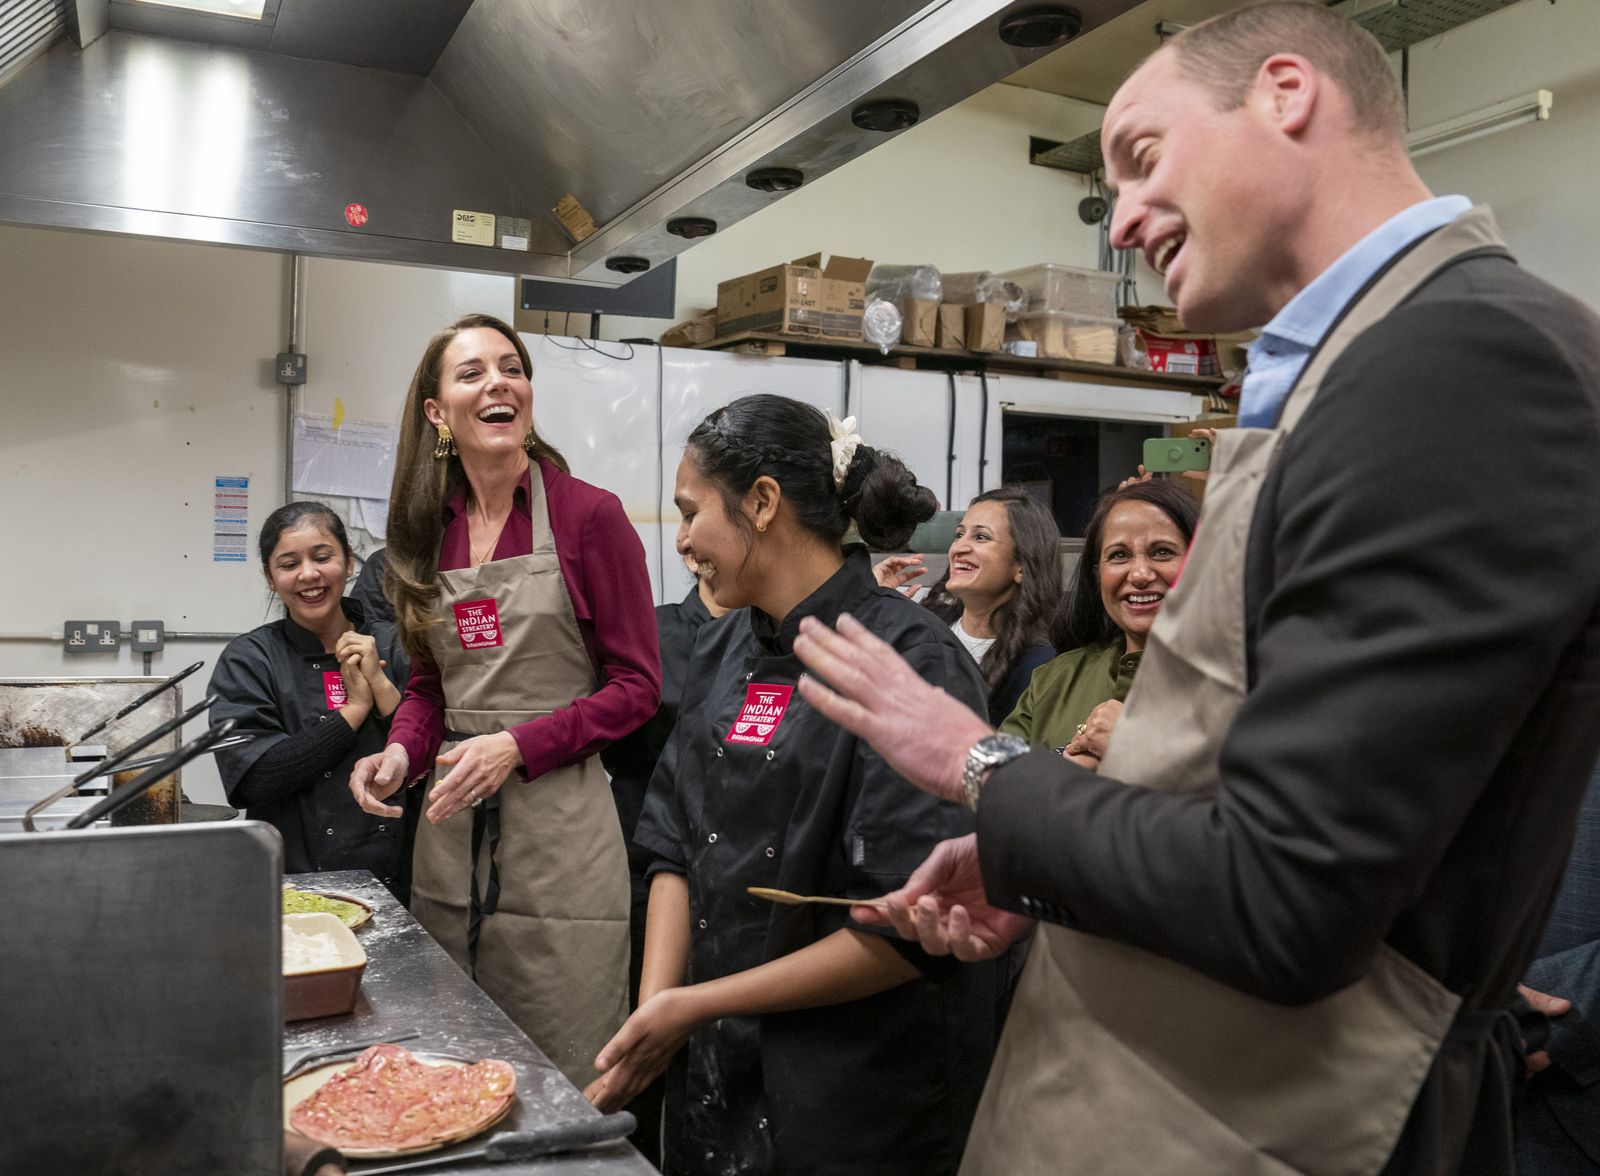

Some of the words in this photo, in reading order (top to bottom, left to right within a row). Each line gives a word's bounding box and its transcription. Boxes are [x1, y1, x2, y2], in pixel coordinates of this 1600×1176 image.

[467, 608, 482, 616] THE
[458, 614, 496, 626] INDIAN
[461, 623, 494, 632] STREATERY
[759, 695, 775, 704] THE
[743, 703, 783, 716] INDIAN
[741, 714, 777, 723] STREATERY
